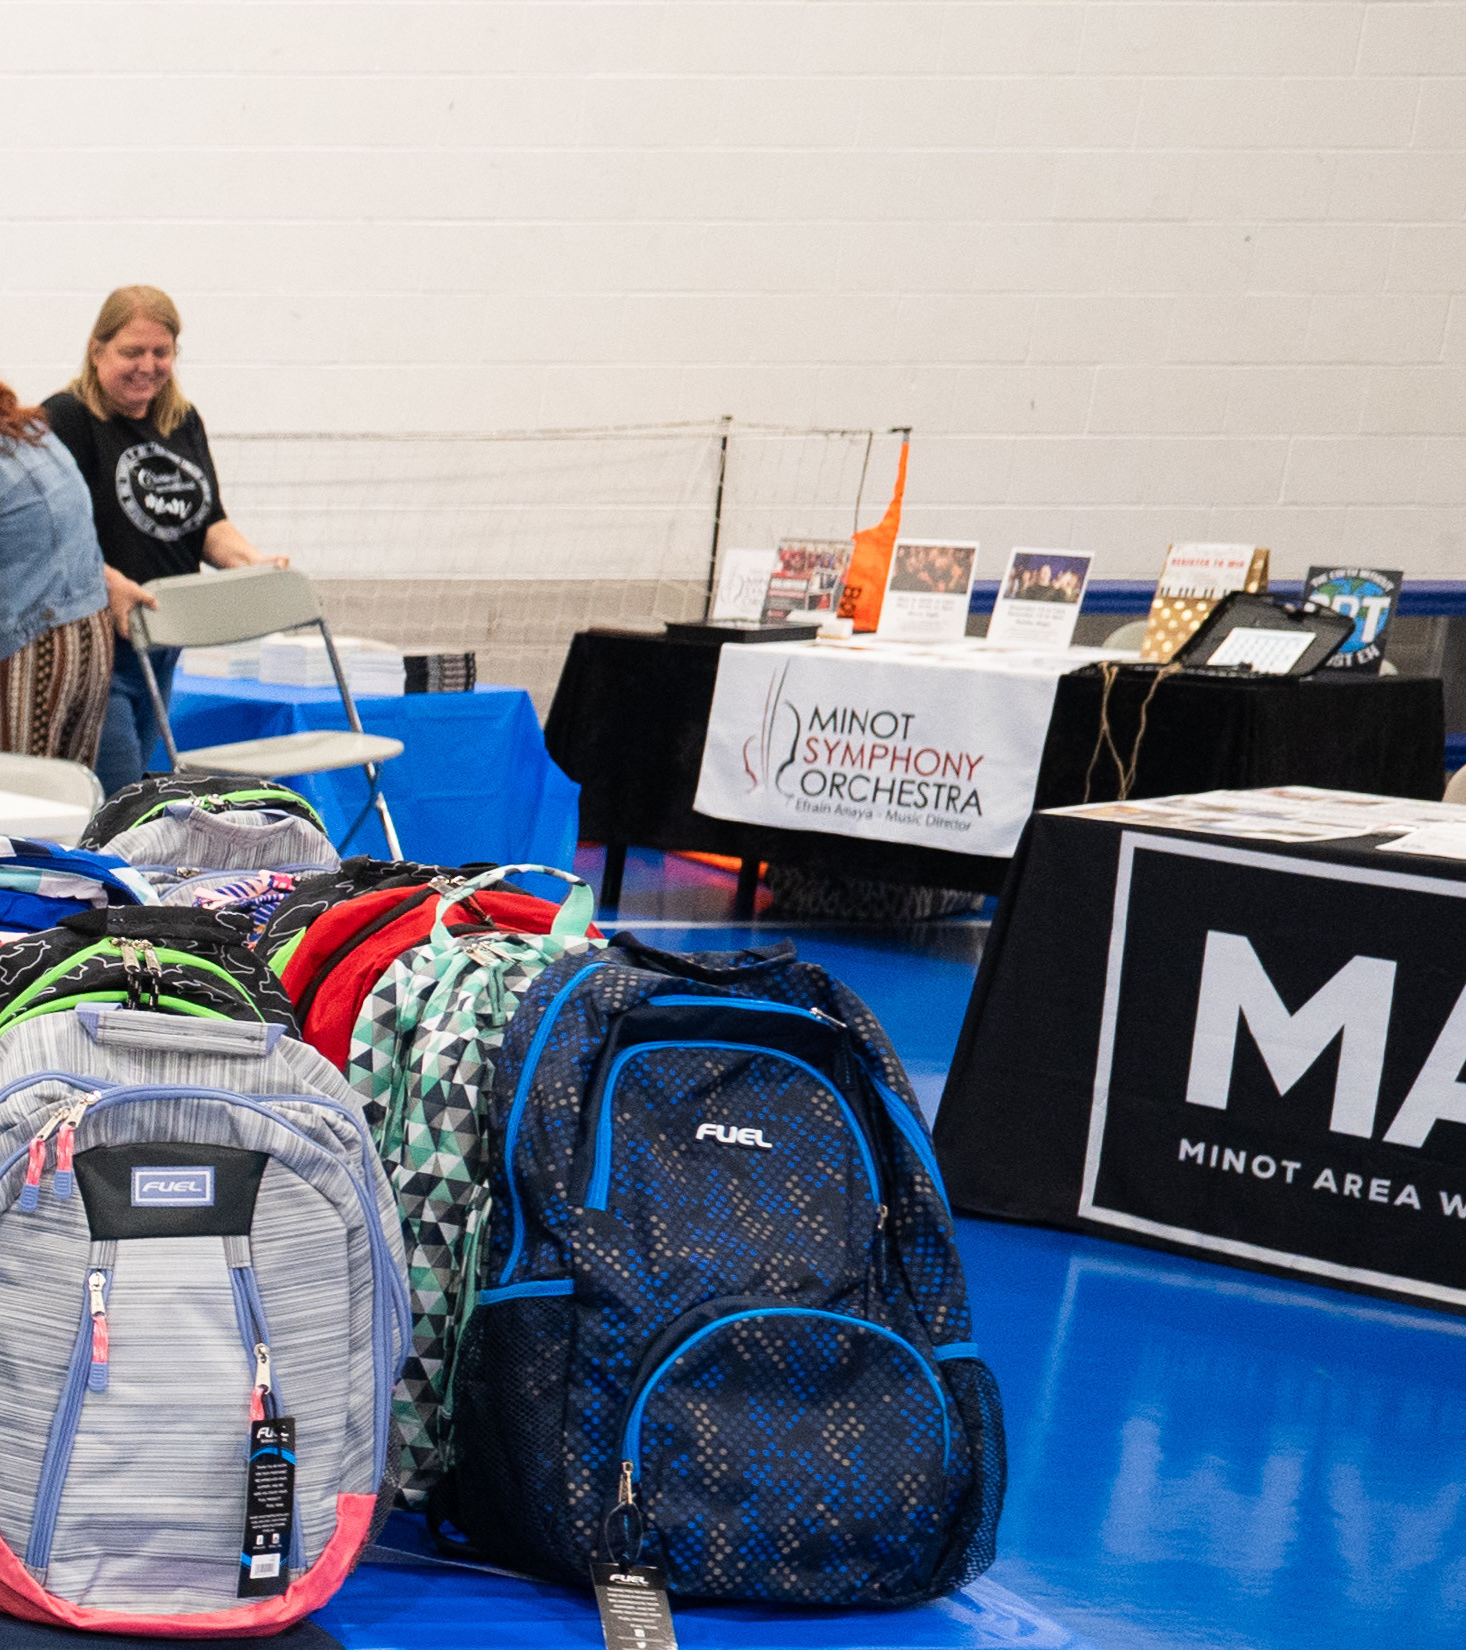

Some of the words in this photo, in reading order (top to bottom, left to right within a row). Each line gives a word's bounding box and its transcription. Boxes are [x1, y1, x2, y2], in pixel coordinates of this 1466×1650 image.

[808, 704, 915, 741] MINOT
[803, 735, 984, 781] SYMPHONY
[800, 769, 983, 817] ORCHESTRA
[885, 810, 920, 826] Music
[695, 1122, 773, 1148] FUEL
[140, 1181, 202, 1193] FUEL
[1178, 1138, 1301, 1184] MINOT
[1313, 1166, 1421, 1210] AREA
[609, 1573, 649, 1585] FUEL
